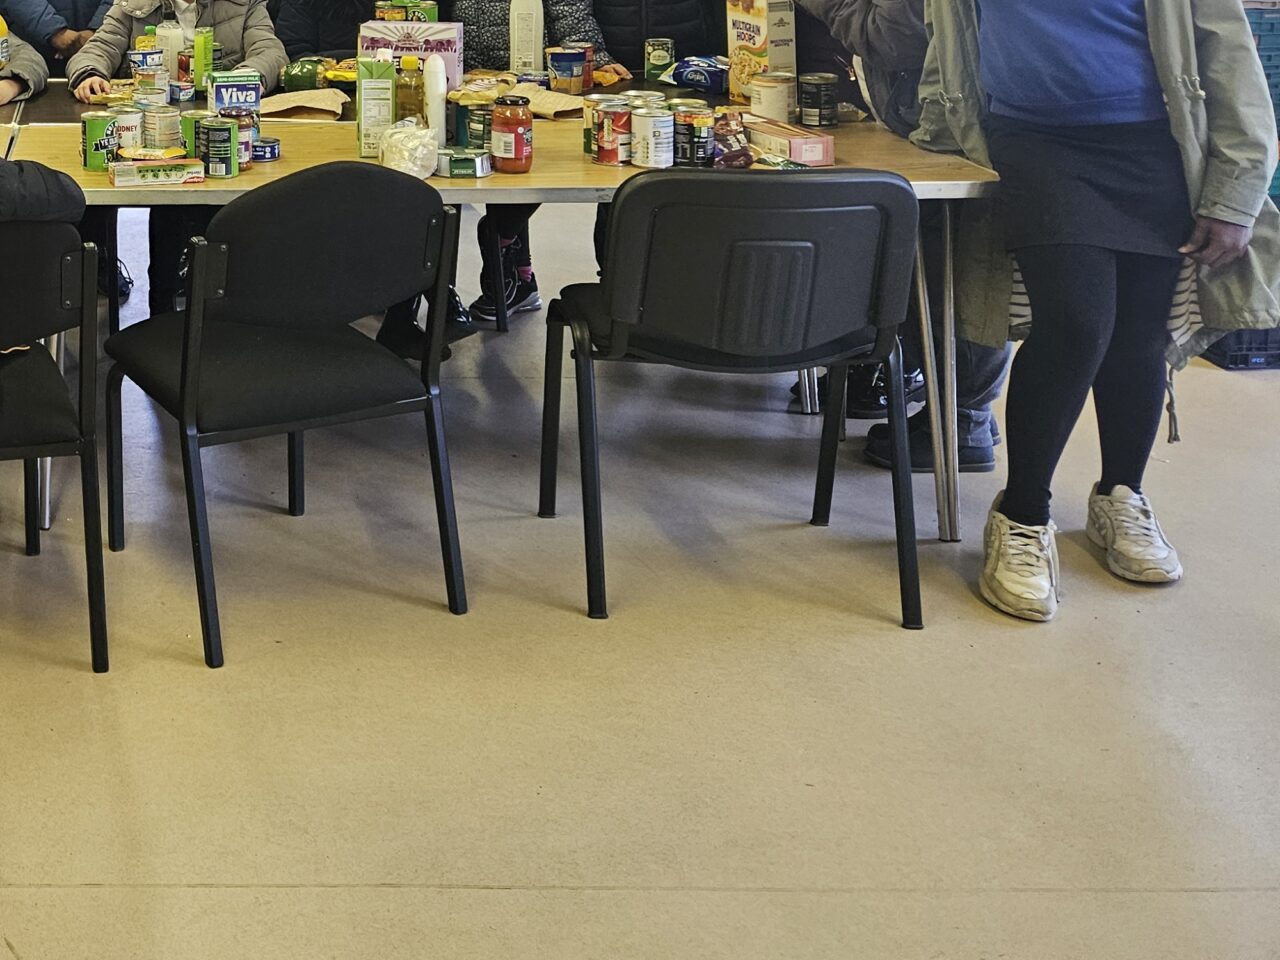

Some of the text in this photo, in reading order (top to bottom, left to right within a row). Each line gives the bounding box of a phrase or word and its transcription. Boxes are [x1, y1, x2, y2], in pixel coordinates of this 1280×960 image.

[732, 19, 761, 36] MULTIGRAIN
[736, 30, 757, 46] HOOPS
[220, 87, 256, 108] Viva
[100, 138, 109, 148] YE
